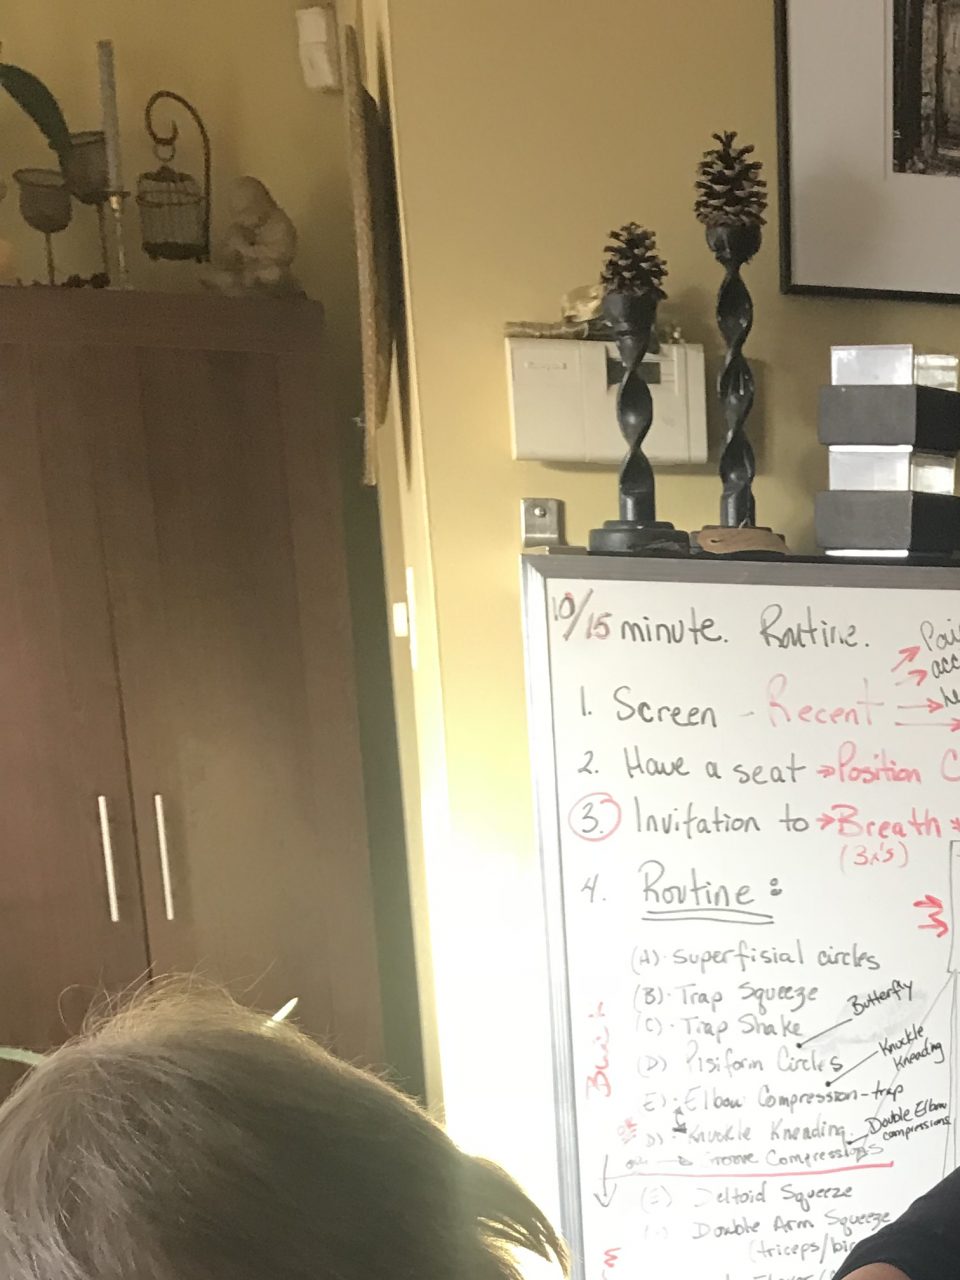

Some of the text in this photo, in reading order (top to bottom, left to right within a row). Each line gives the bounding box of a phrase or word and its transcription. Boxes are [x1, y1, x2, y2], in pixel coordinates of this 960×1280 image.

[580, 673, 884, 728] 1. Screen Recent
[577, 750, 599, 774] 2.
[623, 744, 690, 778] Have
[705, 760, 721, 780] a
[733, 752, 807, 784] seat
[838, 741, 921, 784] Position
[634, 796, 761, 839] Invitation
[778, 803, 809, 832] to
[831, 803, 942, 839] Breath
[817, 942, 881, 971] circles
[674, 982, 723, 1013] Trap
[737, 981, 819, 1015] Squeeze
[848, 979, 914, 1016] Butterfly
[680, 1016, 729, 1044] Trap
[737, 1012, 803, 1037] Shake
[878, 1023, 925, 1057] Knuckle
[777, 1044, 844, 1073] Circles
[893, 1037, 944, 1071] Kneading
[688, 1117, 752, 1144] Knuckle
[865, 1107, 912, 1135] Double
[707, 1150, 759, 1167] roove
[780, 1183, 853, 1212] Squeeze
[692, 1216, 761, 1240] Double
[773, 1215, 815, 1233] Arm
[824, 1208, 891, 1237] Squeeze
